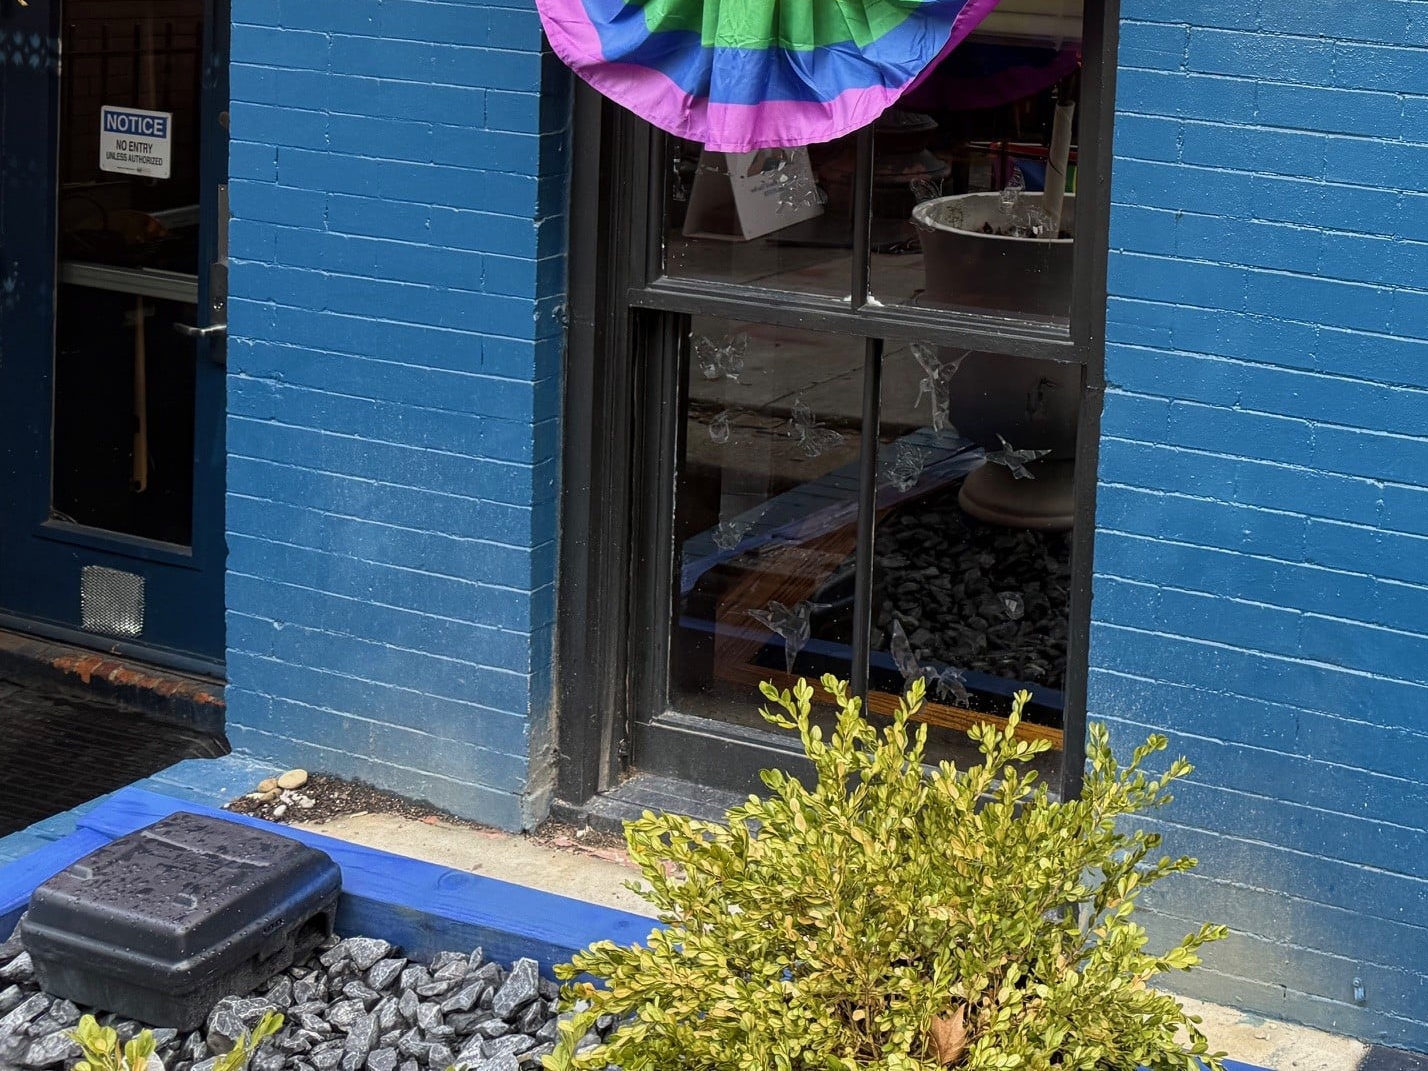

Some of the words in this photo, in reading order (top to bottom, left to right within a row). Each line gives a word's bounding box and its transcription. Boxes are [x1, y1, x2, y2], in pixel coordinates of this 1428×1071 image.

[106, 113, 164, 136] NOTICE
[116, 139, 127, 151] NO
[128, 141, 153, 154] ENTRY
[106, 151, 127, 162] UNLESS
[127, 154, 163, 166] AUTHORIZED
